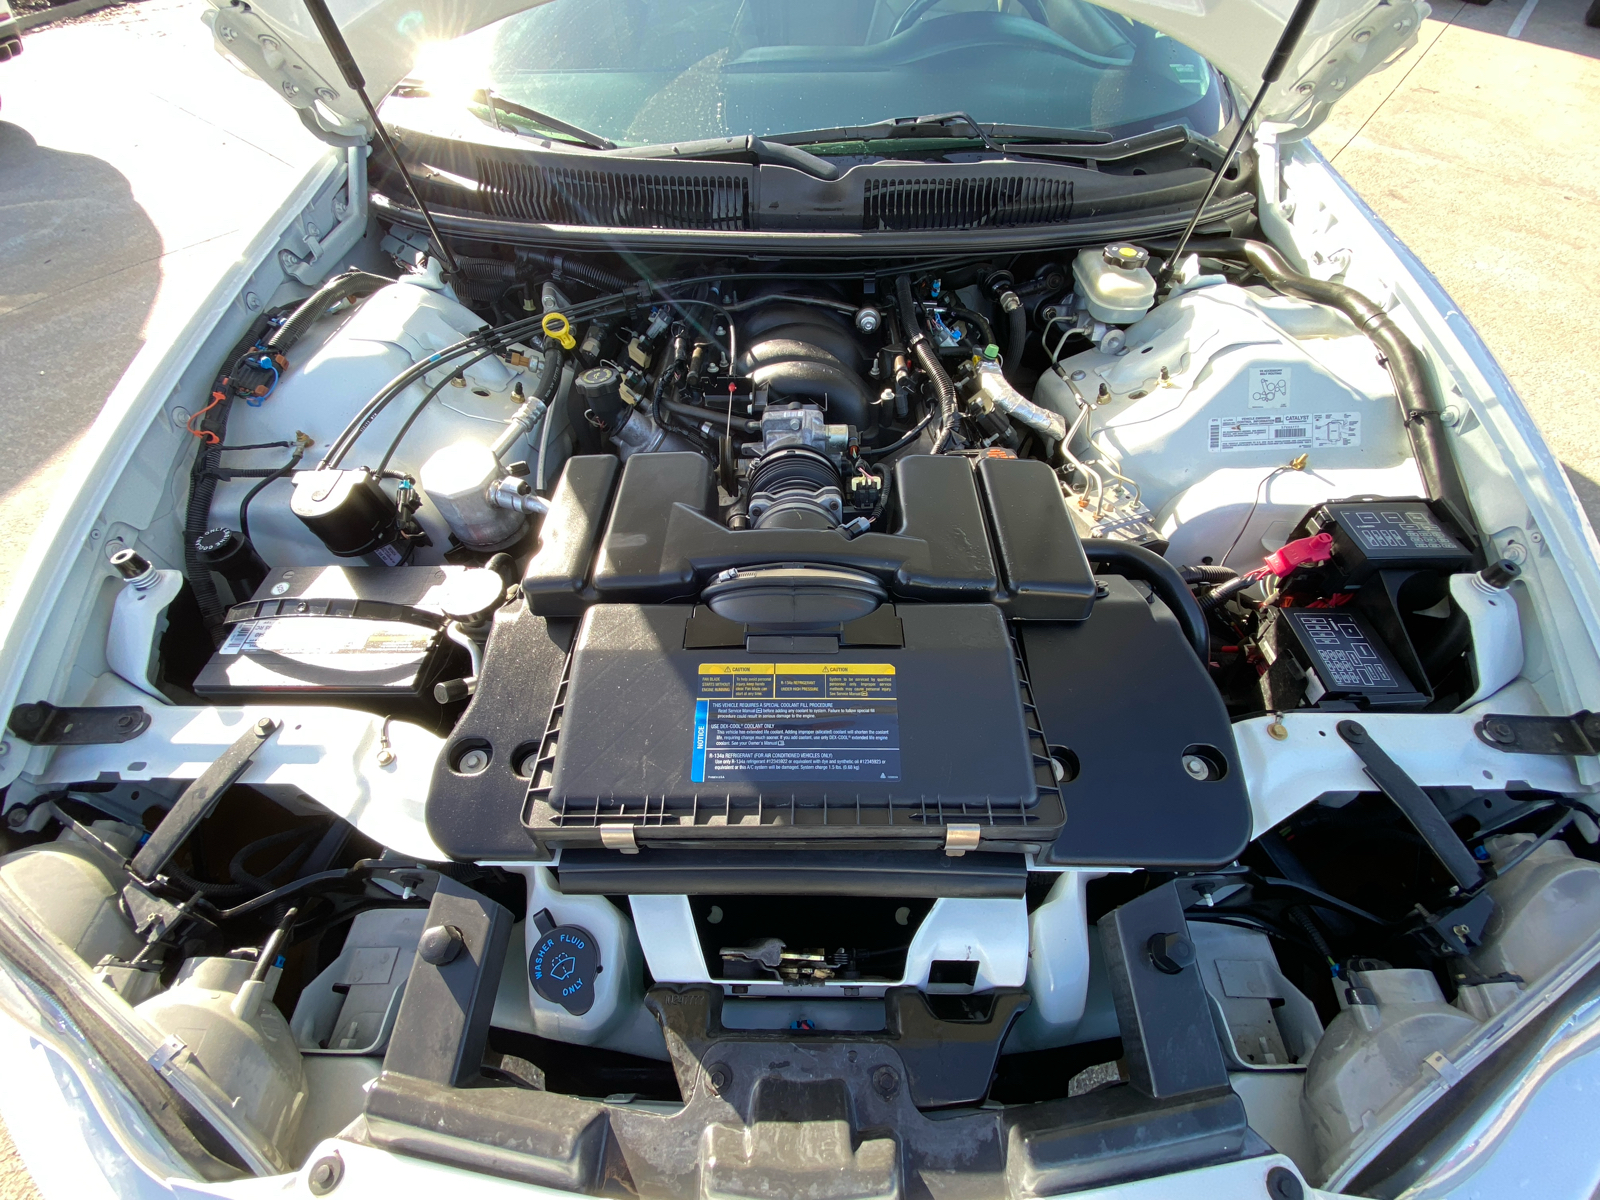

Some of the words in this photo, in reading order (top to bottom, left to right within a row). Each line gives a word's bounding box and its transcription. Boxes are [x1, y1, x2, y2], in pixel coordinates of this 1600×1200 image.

[560, 934, 585, 949] FLUID
[535, 939, 554, 979] WASHER
[562, 978, 583, 996] ONLY
